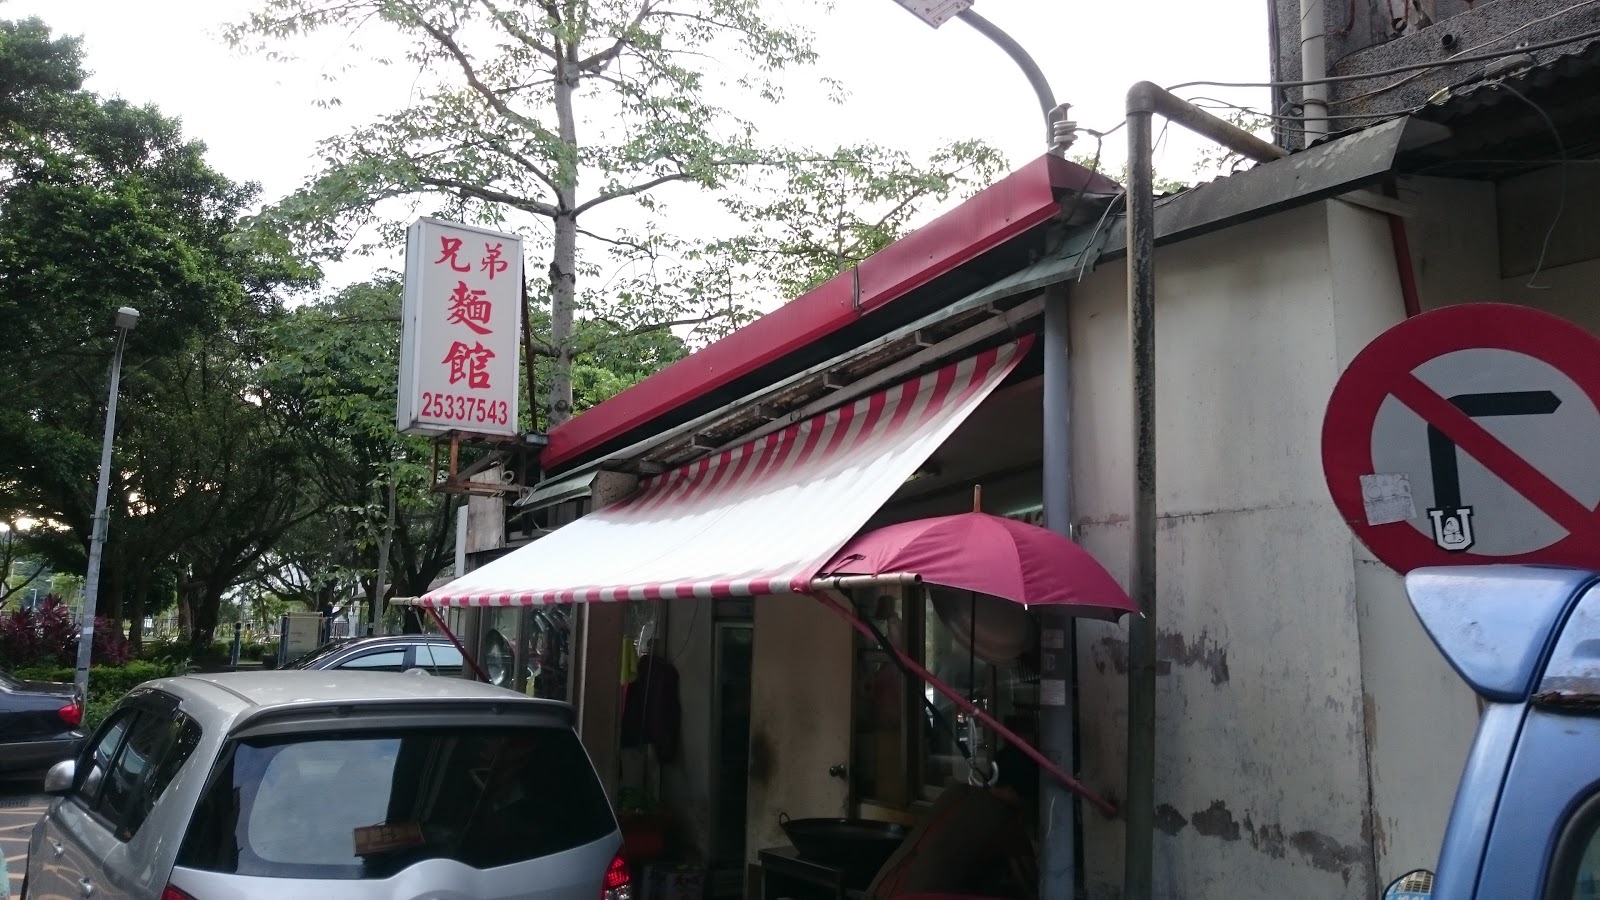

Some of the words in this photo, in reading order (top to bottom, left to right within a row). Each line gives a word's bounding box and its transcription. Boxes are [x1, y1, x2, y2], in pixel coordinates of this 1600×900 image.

[434, 236, 508, 280] 兄弟
[441, 281, 496, 389] 麵館
[421, 391, 508, 425] 25337543
